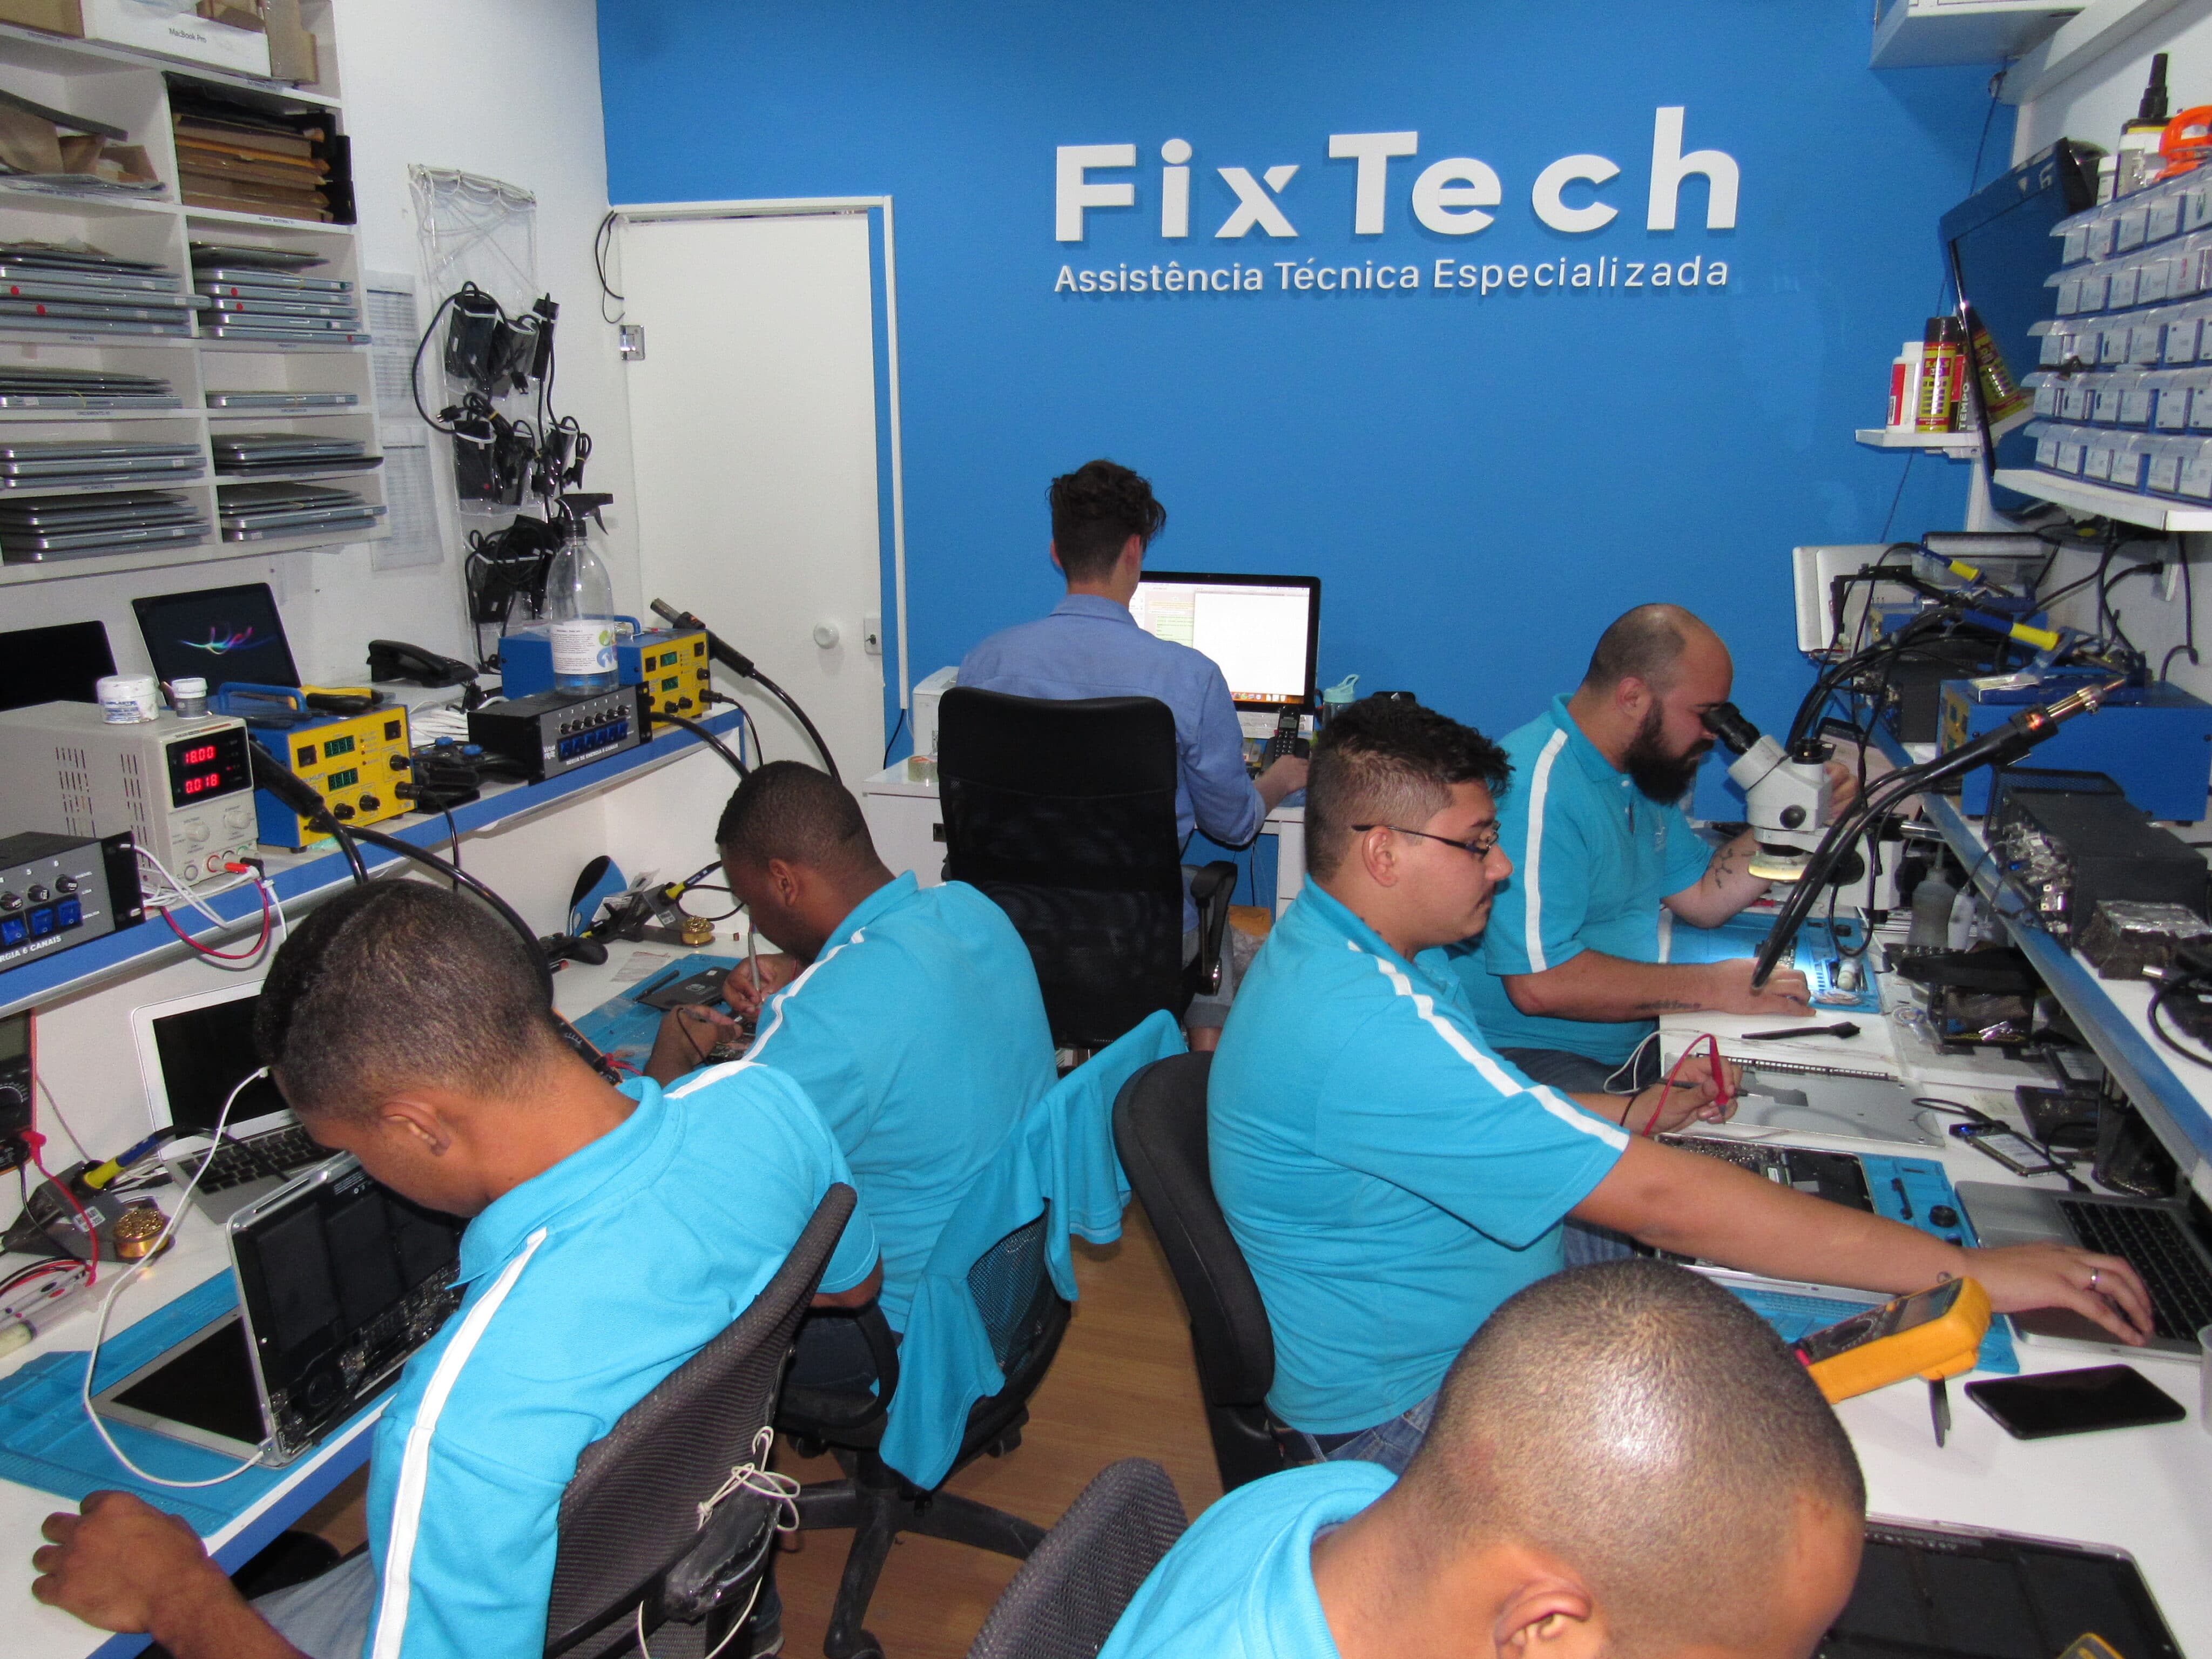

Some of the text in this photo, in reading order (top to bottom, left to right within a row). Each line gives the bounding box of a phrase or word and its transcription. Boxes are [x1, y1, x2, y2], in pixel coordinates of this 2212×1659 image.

[168, 28, 207, 43] MacBook Pro
[1054, 255, 1728, 295] Assistência Técnica Especializada
[1958, 383, 1970, 430] TEMPO
[30, 935, 62, 952] CANAIS
